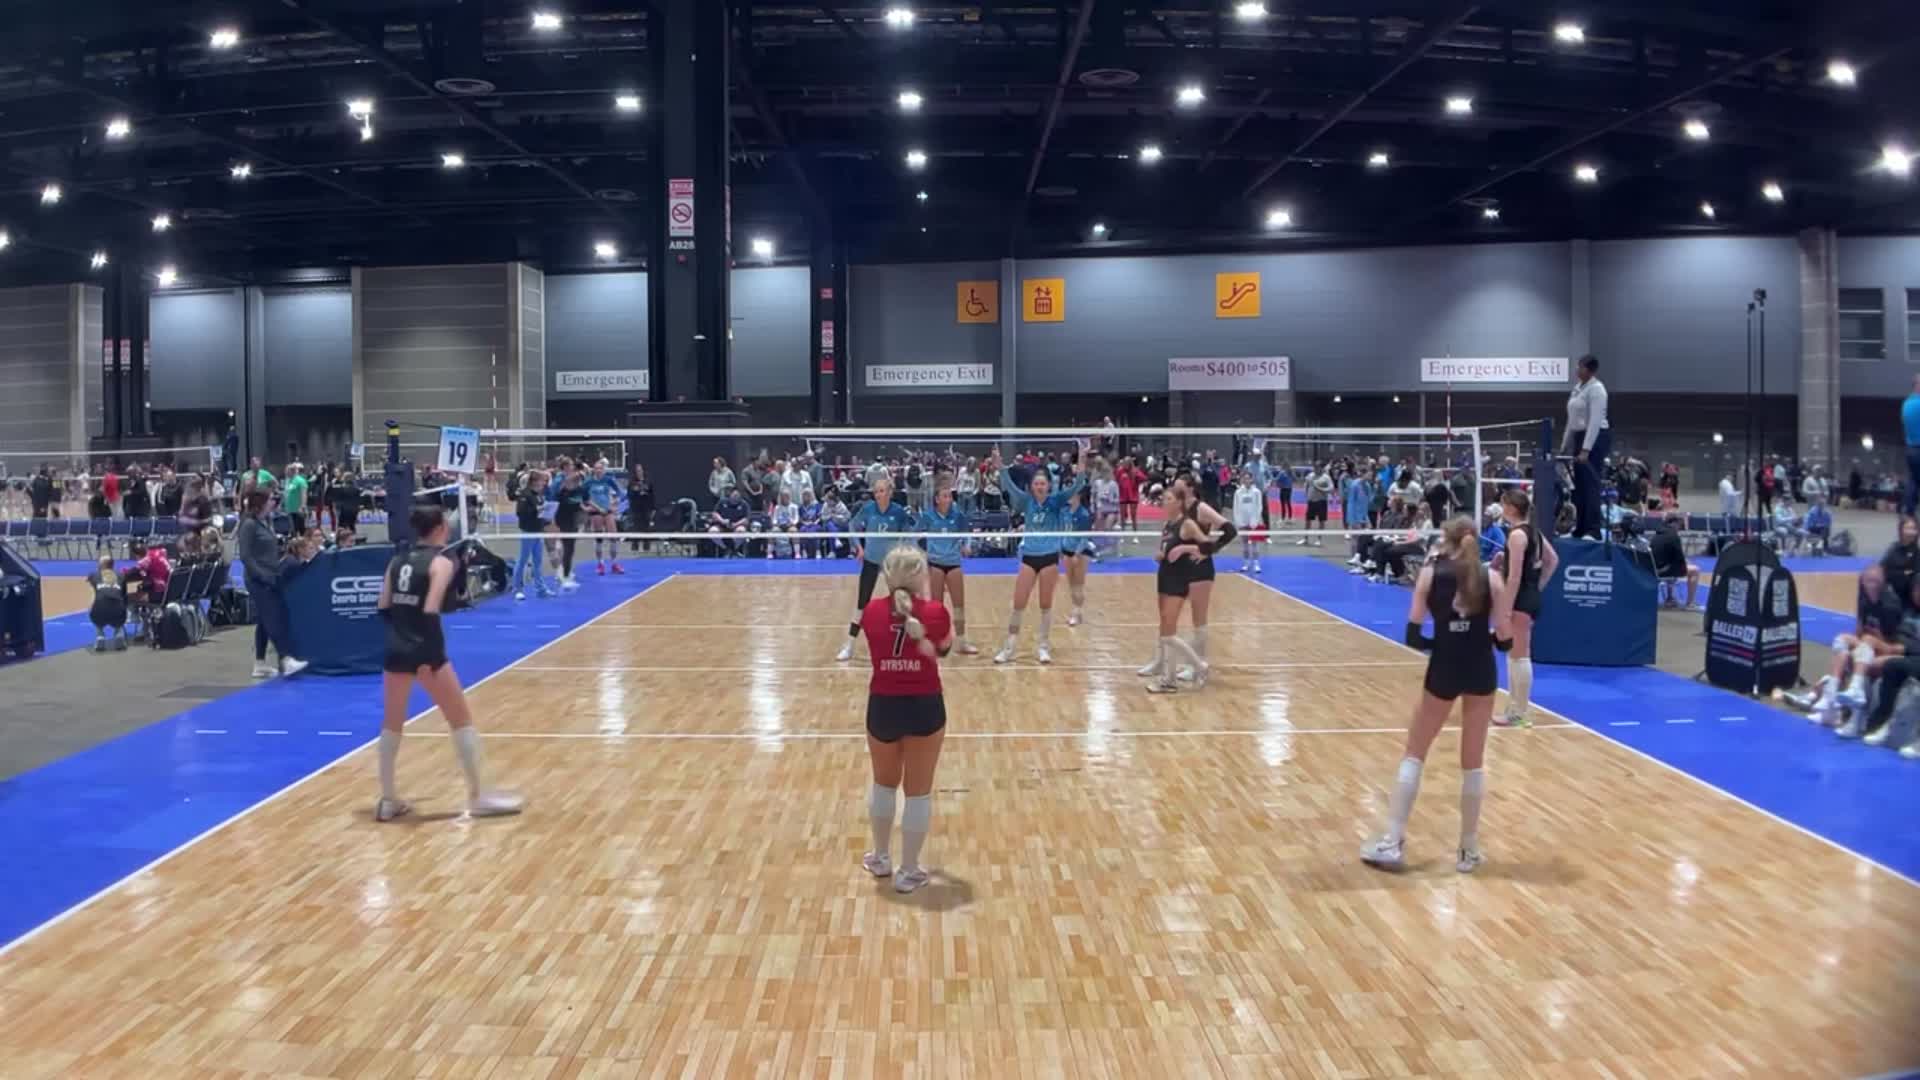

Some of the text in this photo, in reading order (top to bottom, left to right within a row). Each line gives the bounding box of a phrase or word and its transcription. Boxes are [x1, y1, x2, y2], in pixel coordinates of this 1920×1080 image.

[872, 366, 986, 383] Emergency Exit
[1206, 361, 1246, 376] S400
[1258, 361, 1287, 376] 505
[1429, 360, 1561, 378] Emergency Exit
[561, 373, 638, 389] Emergency
[449, 440, 468, 466] 19
[398, 564, 413, 592] 8
[1564, 565, 1613, 583] CG
[331, 576, 385, 593] CG
[890, 623, 911, 657] 7
